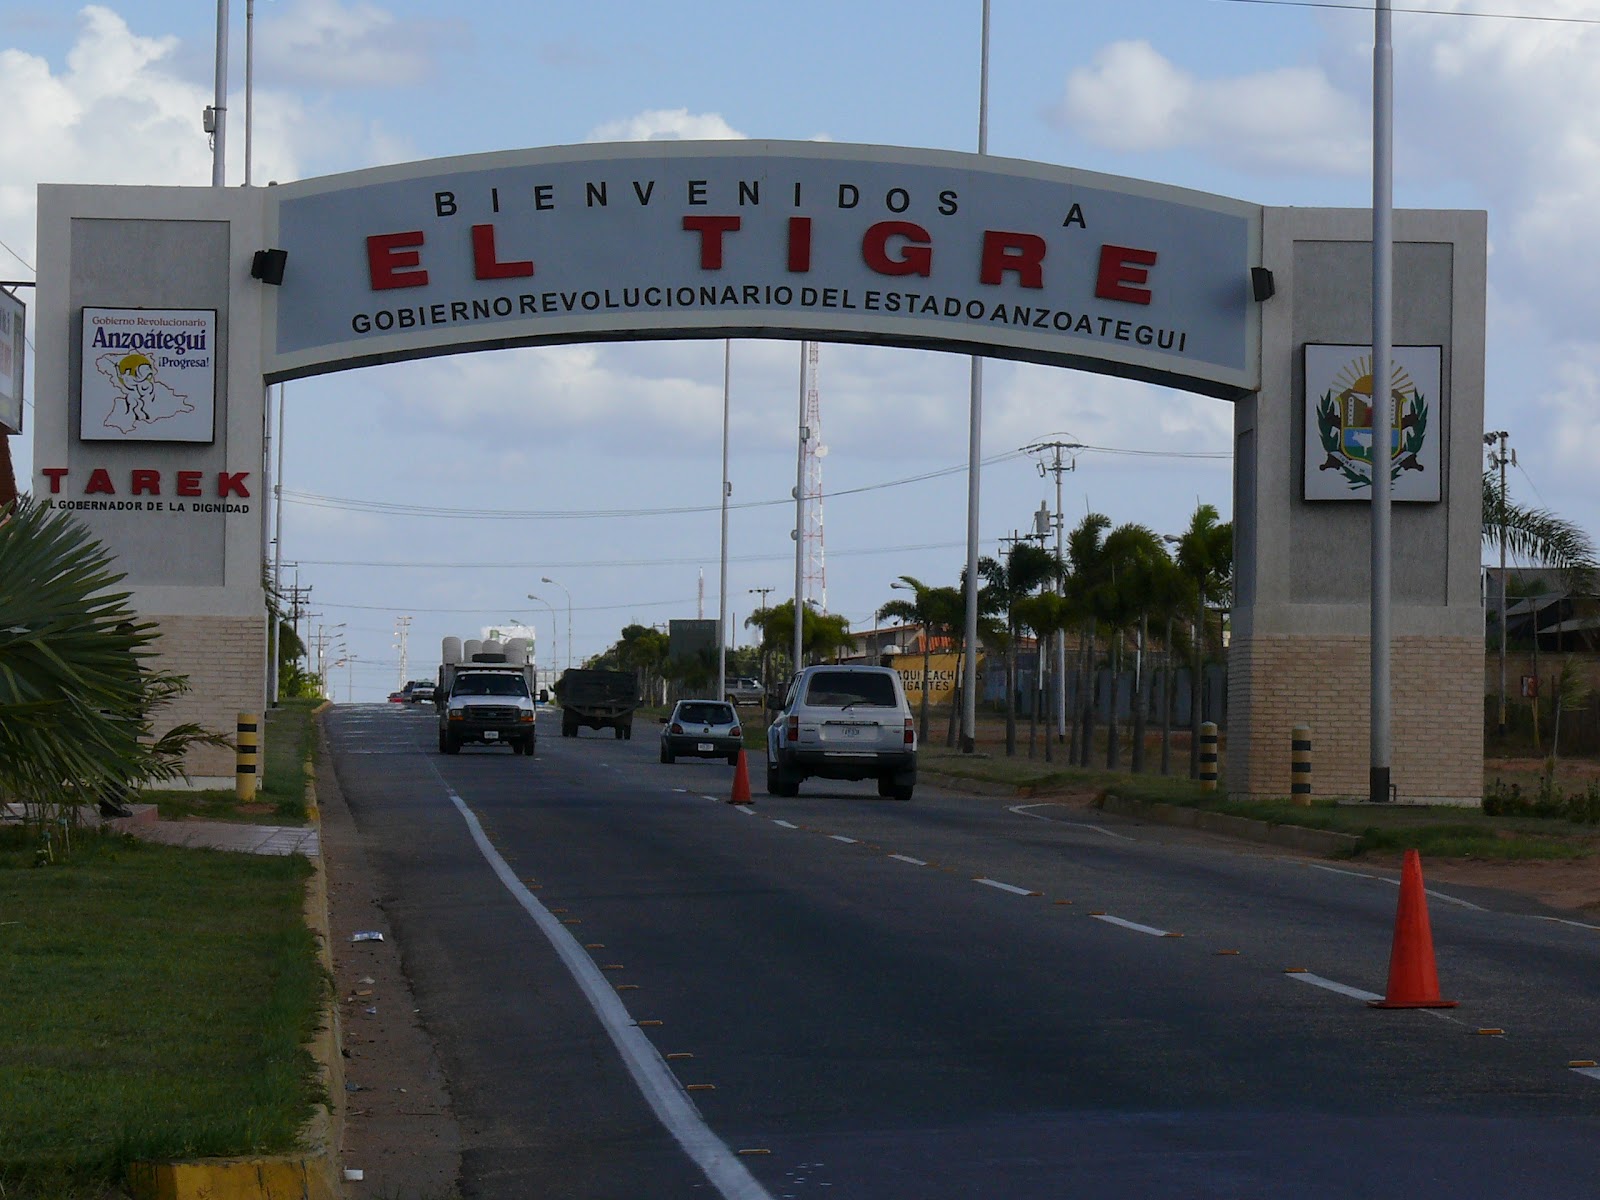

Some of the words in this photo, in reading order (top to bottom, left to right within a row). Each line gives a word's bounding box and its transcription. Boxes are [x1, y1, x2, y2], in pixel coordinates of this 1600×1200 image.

[435, 181, 958, 217] BIENVENIDOS
[1062, 203, 1087, 229] A
[367, 224, 534, 290] EL
[683, 216, 1157, 305] TIGRE
[92, 316, 135, 326] Gobierno
[137, 317, 207, 327] Revolucionario
[352, 296, 513, 333] GOBIERNO
[519, 286, 793, 314] REVOLUCIONARIO
[801, 287, 856, 309] DEL
[864, 291, 985, 319] ESTADO
[989, 304, 1186, 352] ANZOATEGUI
[92, 327, 207, 355] Anzoátegui
[42, 468, 251, 498] TAREK
[58, 500, 143, 511] GOBERNADOR
[147, 501, 163, 512] DE
[169, 502, 185, 513] LA
[193, 502, 250, 514] DIGNIDAD
